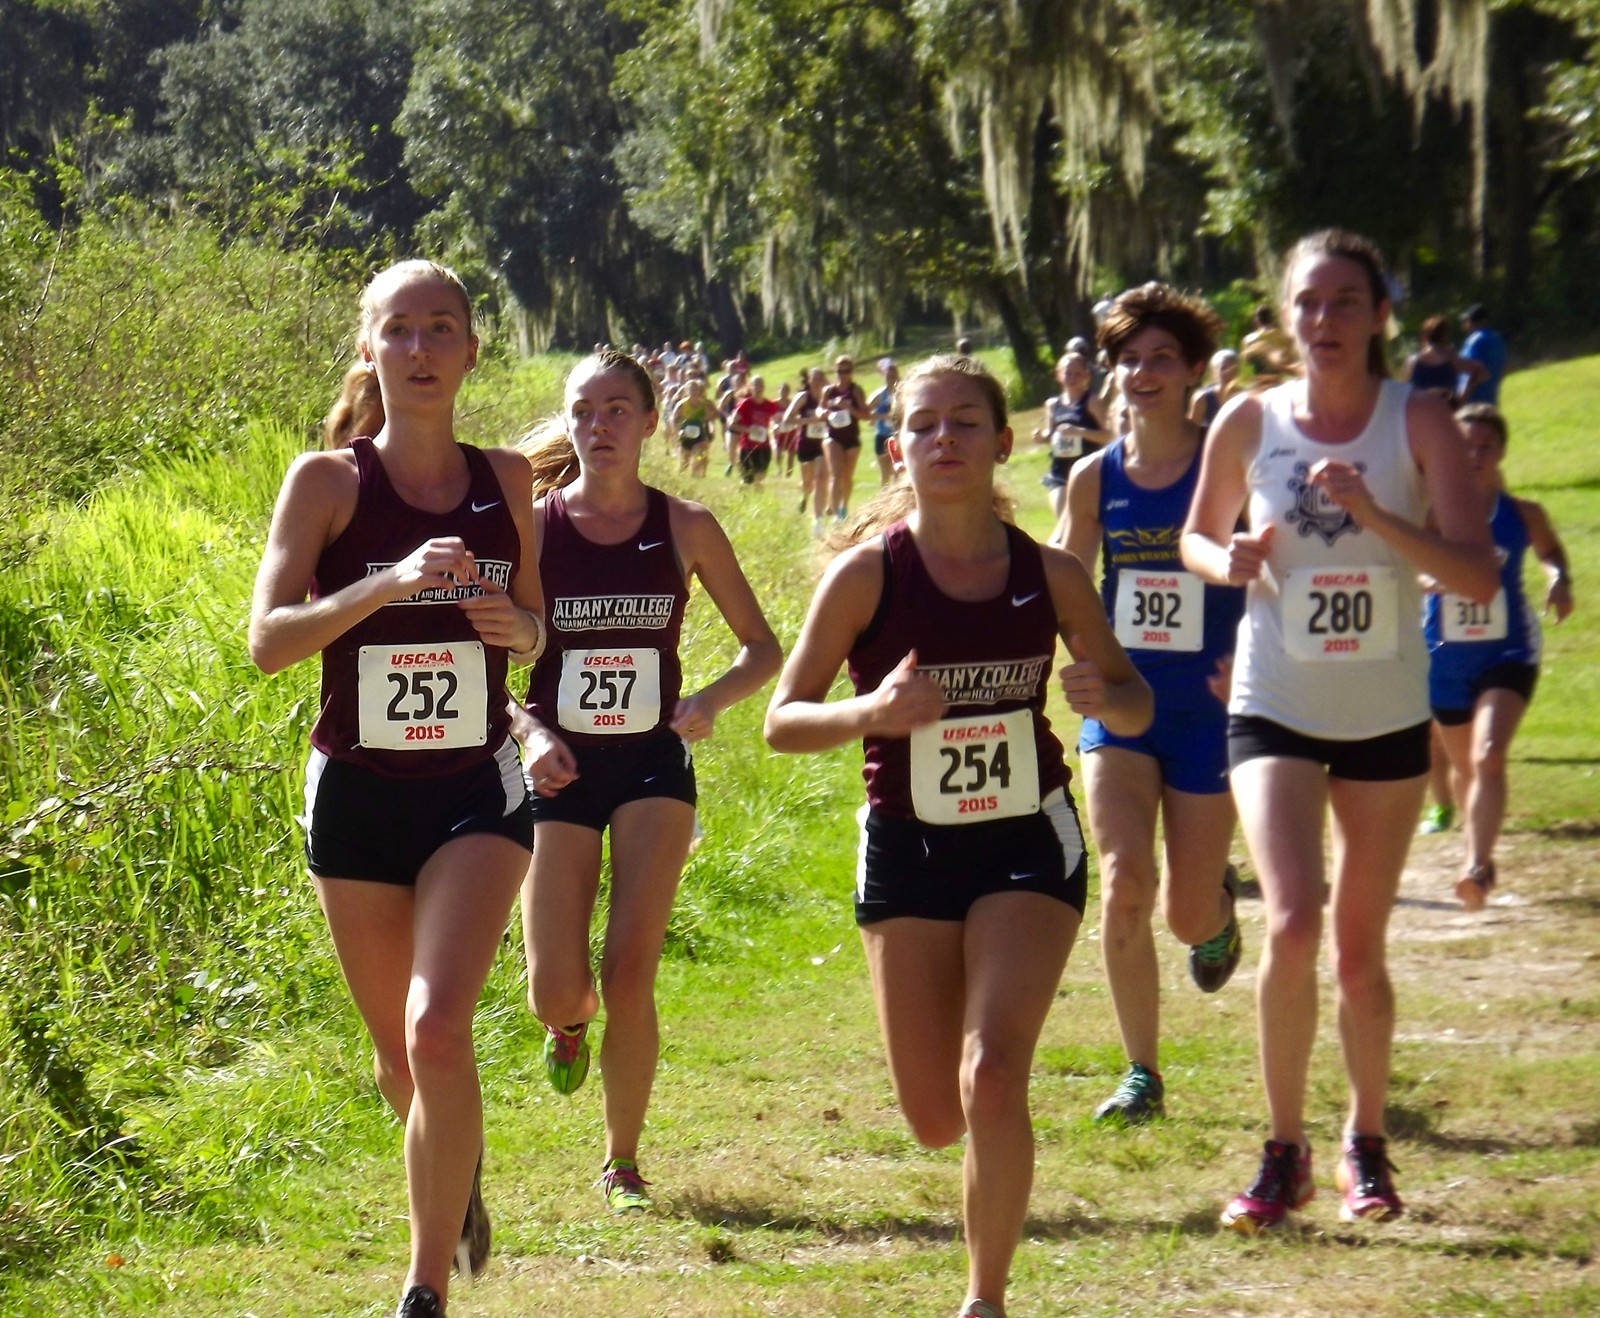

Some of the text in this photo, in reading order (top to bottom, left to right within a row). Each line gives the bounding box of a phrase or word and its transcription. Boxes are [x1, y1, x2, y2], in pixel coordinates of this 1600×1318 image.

[1135, 575, 1180, 589] USCAA
[1312, 570, 1370, 587] USCAA
[420, 590, 434, 599] AND
[434, 588, 470, 600] HEALTH
[556, 598, 671, 619] ALBANY COLLEGE
[1132, 590, 1182, 629] 392
[1308, 590, 1373, 635] 280
[1456, 601, 1491, 626] 311
[560, 618, 597, 629] PHARMACY
[607, 617, 636, 627] HEALTH
[1142, 630, 1172, 644] 2015
[1323, 638, 1361, 654] 2015
[390, 649, 455, 665] USCAA
[583, 654, 634, 666] USCAA
[917, 667, 981, 689] BANY
[386, 670, 459, 721] 252
[579, 669, 637, 710] 257
[593, 714, 626, 727] 2015
[404, 725, 445, 741] 2015
[943, 720, 1008, 741] USCAA
[939, 741, 1011, 795] 254
[958, 796, 999, 813] 2015
